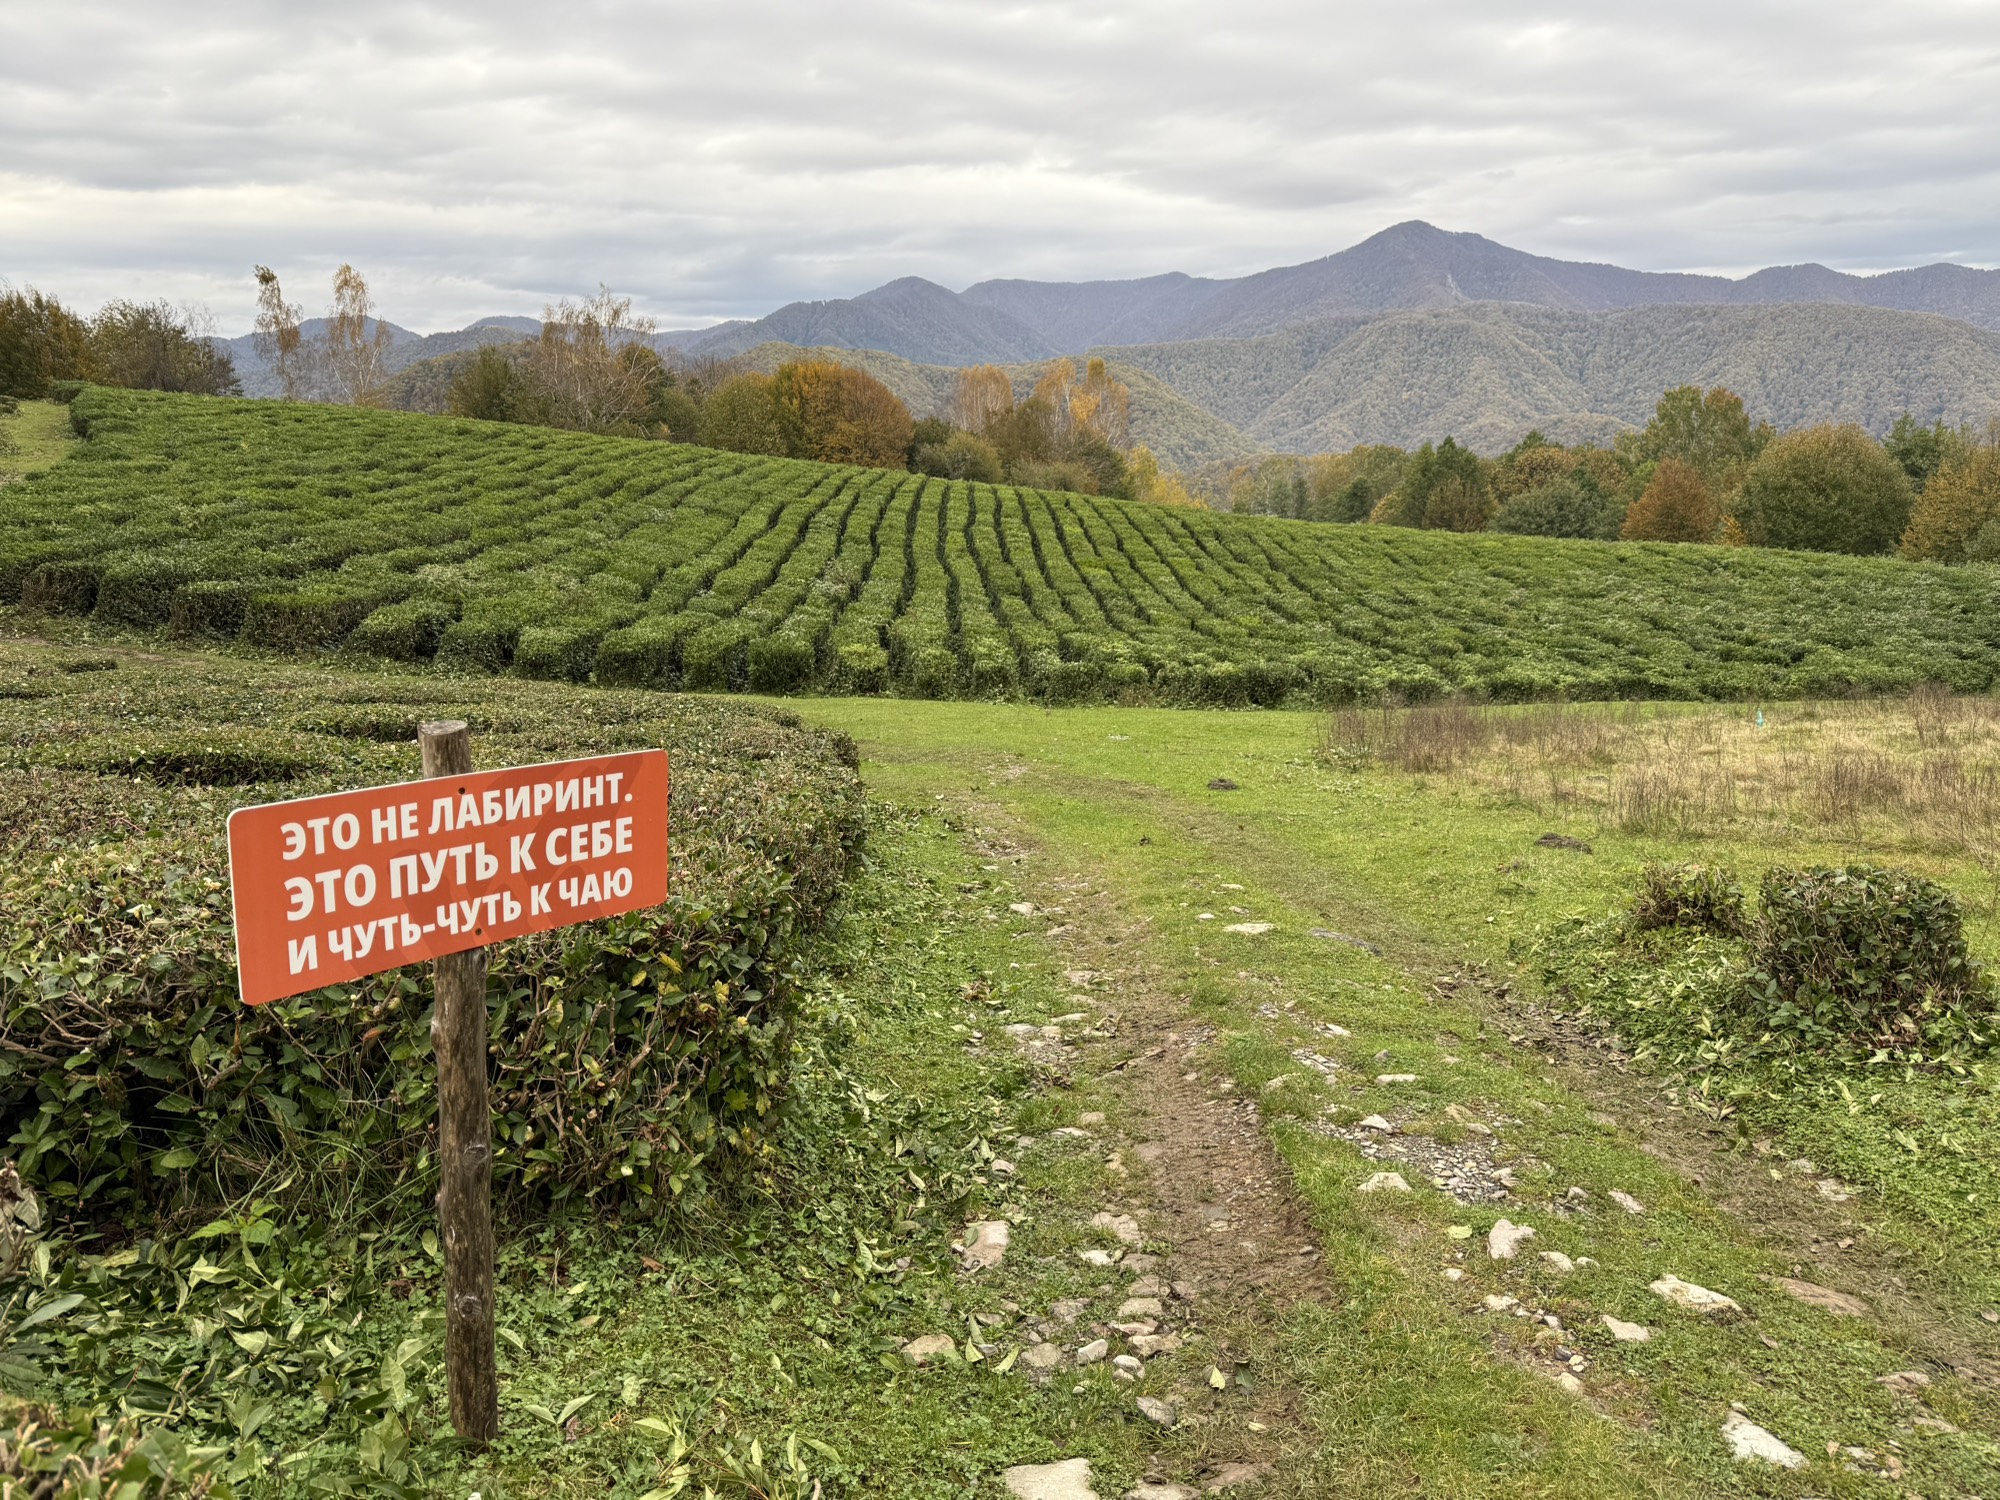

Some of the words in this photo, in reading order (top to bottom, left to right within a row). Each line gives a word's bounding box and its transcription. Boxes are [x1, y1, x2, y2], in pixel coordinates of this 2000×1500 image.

[281, 814, 359, 860] ЭТО
[372, 803, 418, 843] НЕ
[429, 773, 633, 834] ЛАБИРИНТ.
[284, 865, 376, 921] ЭТО
[390, 842, 498, 898] ПУТЬ
[511, 833, 536, 873] К
[546, 817, 633, 866] СЕБЕ
[288, 935, 318, 975] И
[328, 892, 522, 961] ЧУТЬ-ЧУТЬ
[531, 883, 552, 916] К
[559, 868, 633, 907] ЧАЮ
